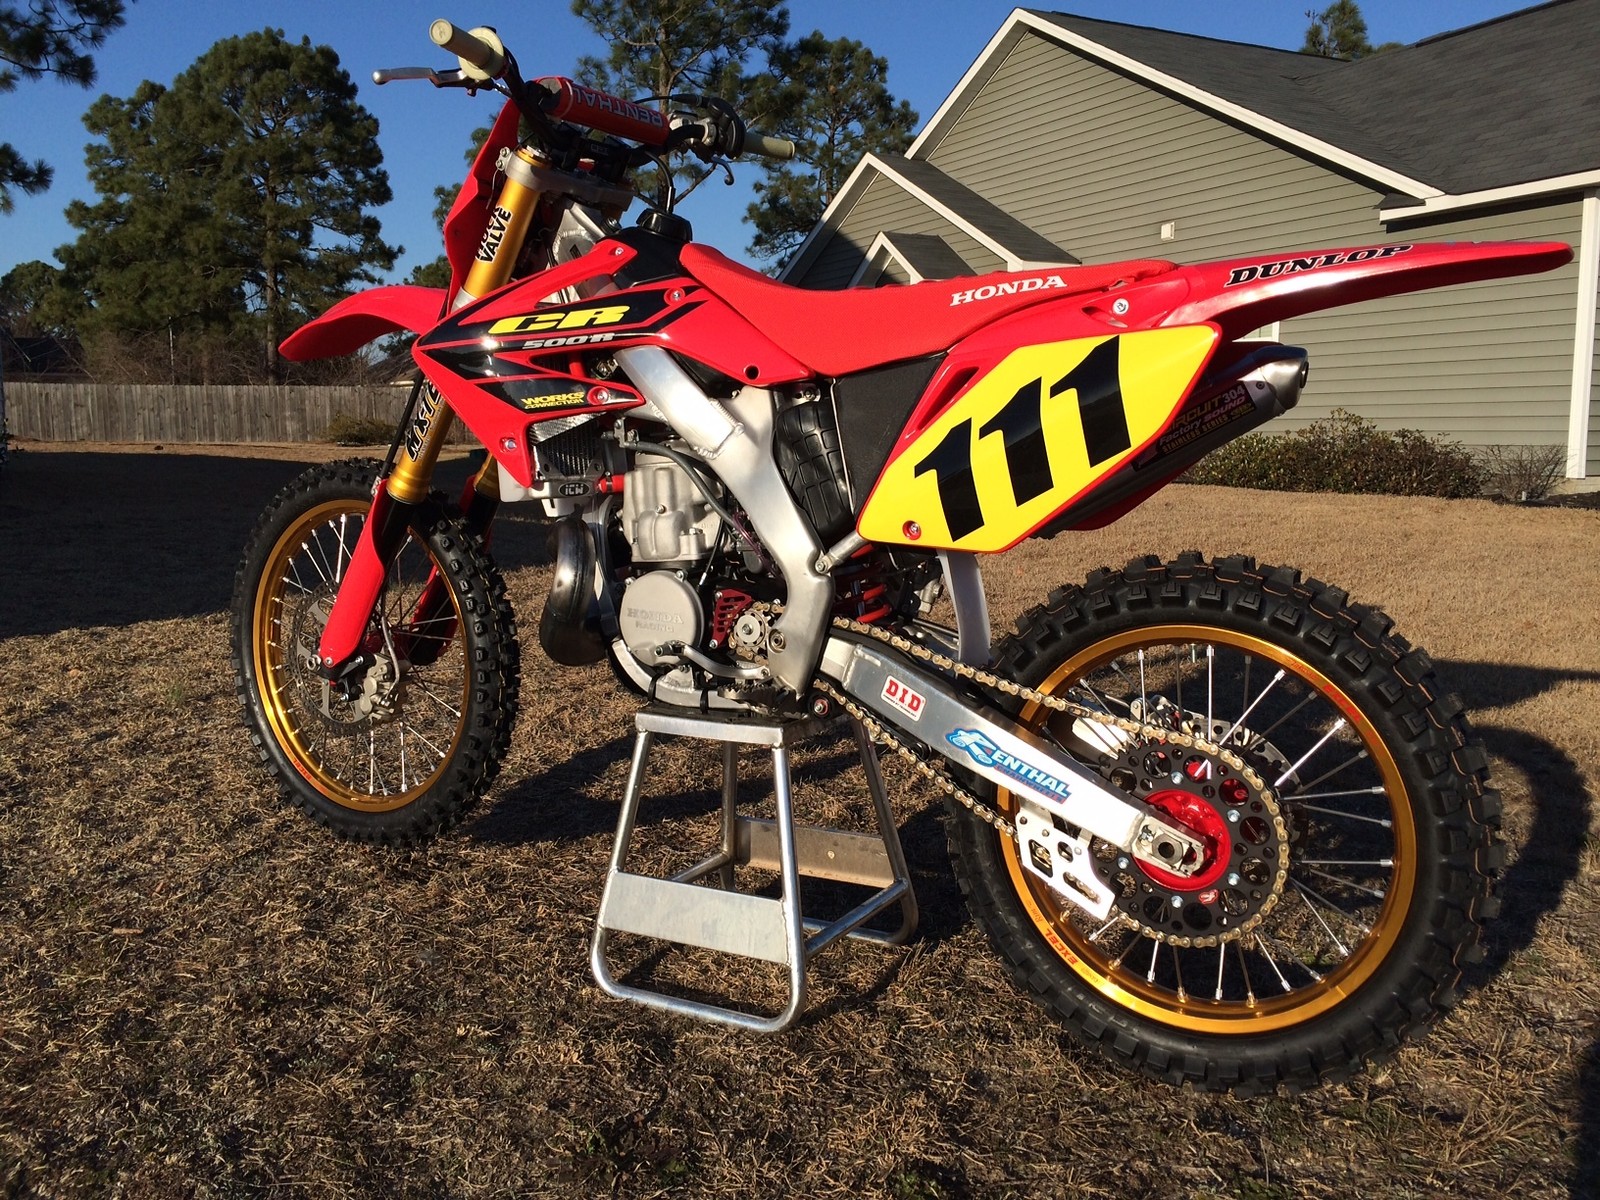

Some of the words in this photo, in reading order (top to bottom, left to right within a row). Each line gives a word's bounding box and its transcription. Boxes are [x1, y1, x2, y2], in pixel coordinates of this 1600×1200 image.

[572, 88, 663, 127] RENTHAL
[480, 207, 512, 262] VALVE
[1224, 245, 1413, 287] DUNLOP
[950, 276, 1067, 306] HONDA
[488, 306, 630, 334] CR
[522, 333, 615, 349] 500R
[521, 392, 585, 405] WORKS
[524, 399, 585, 409] CONNECTION
[1168, 395, 1221, 431] IRCUIT
[1222, 385, 1246, 403] 304
[914, 335, 1131, 542] 111
[1160, 420, 1201, 445] Factory
[1204, 397, 1246, 422] SOUND
[1162, 430, 1200, 453] STAINLESS
[1202, 414, 1229, 432] SERIES
[627, 607, 685, 624] HONDA
[635, 620, 675, 633] RACING
[1045, 928, 1079, 965] EXCEL
